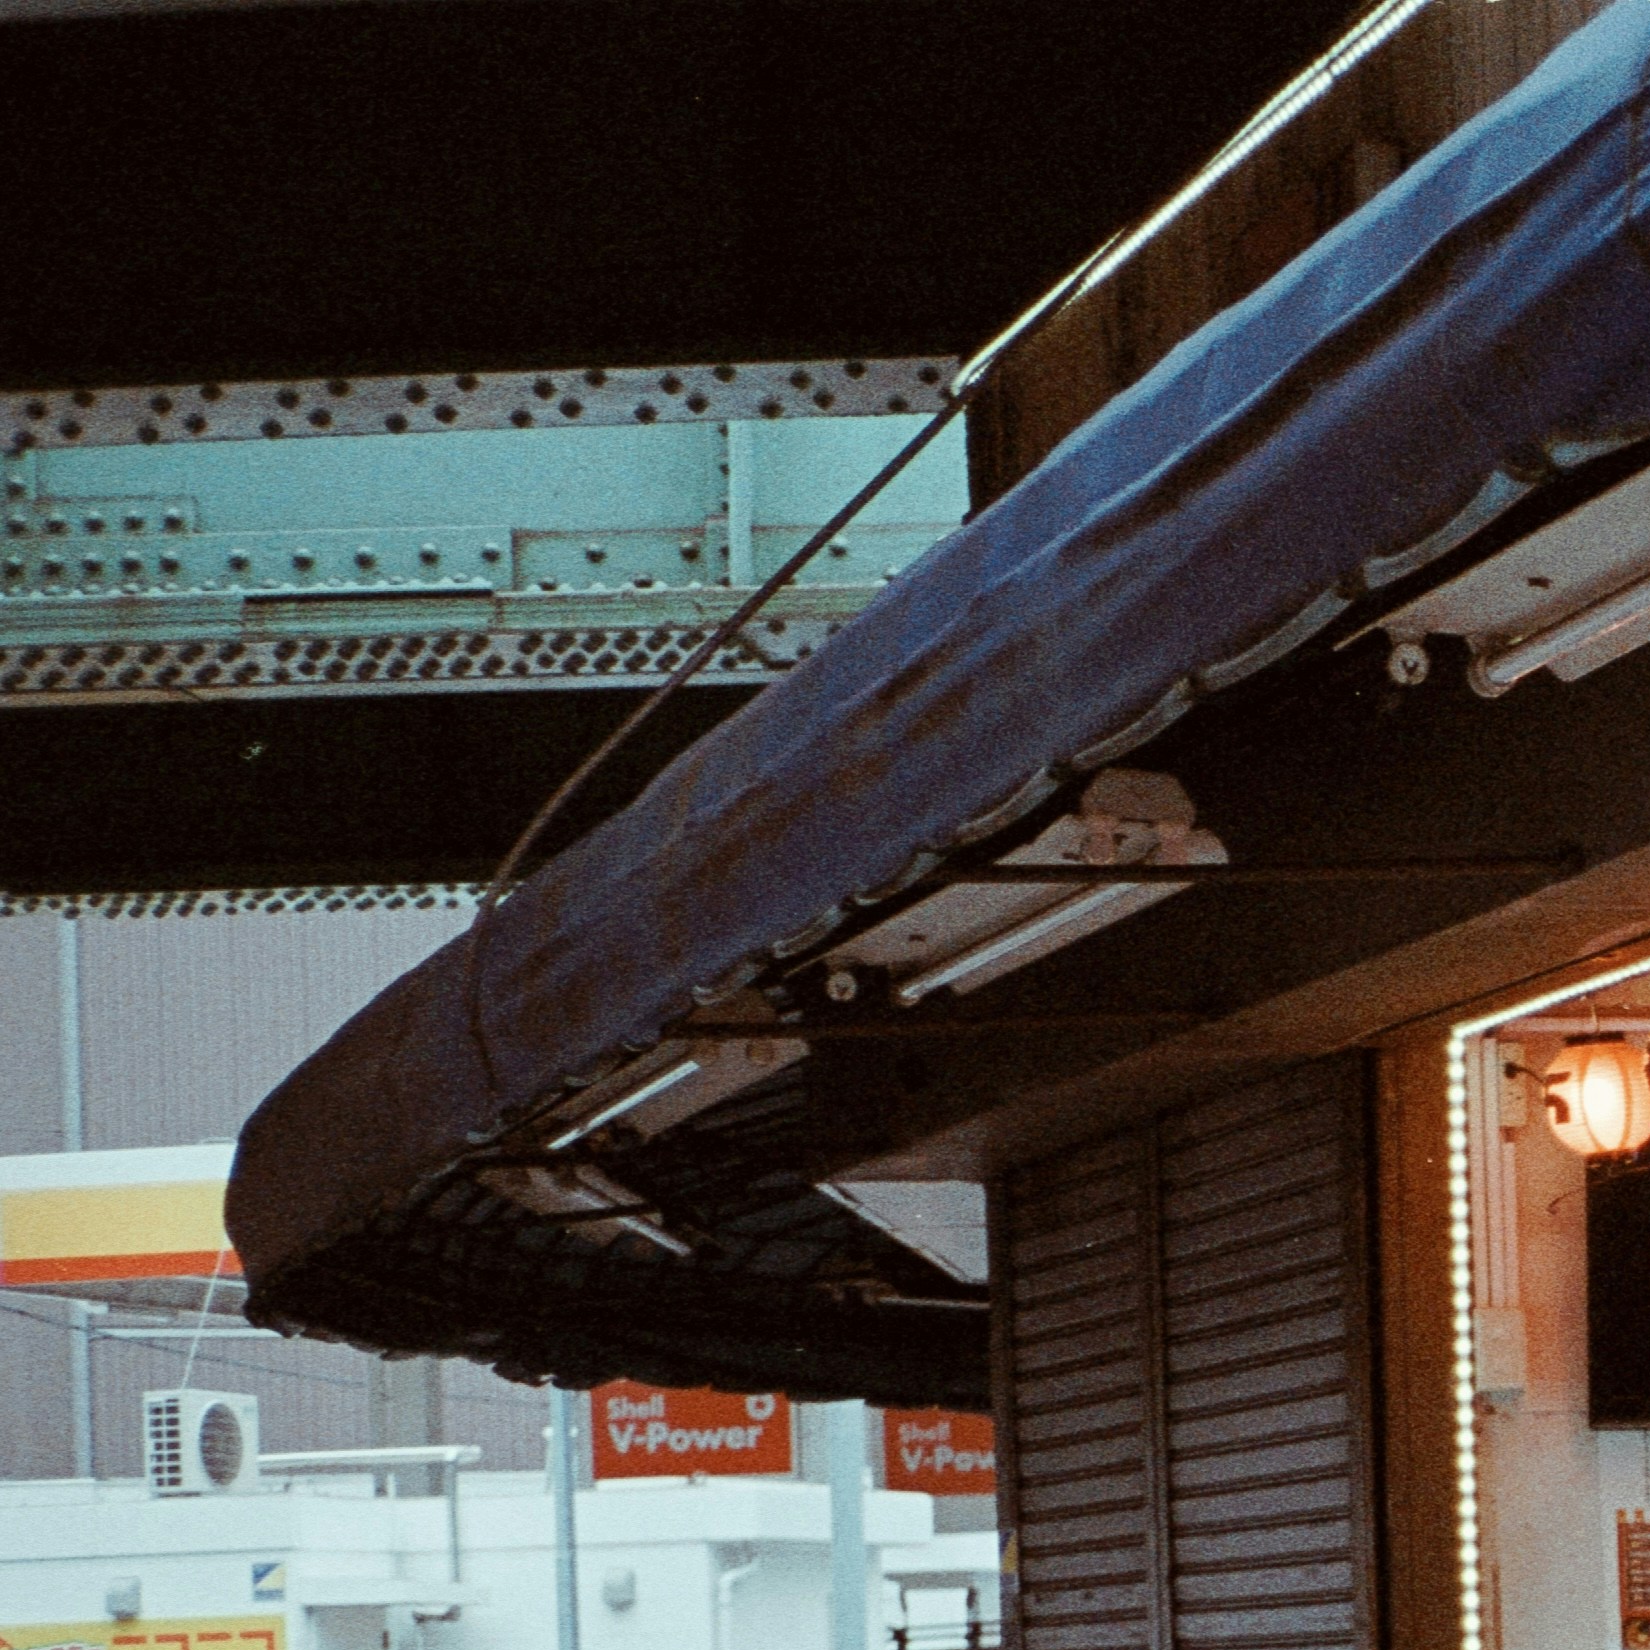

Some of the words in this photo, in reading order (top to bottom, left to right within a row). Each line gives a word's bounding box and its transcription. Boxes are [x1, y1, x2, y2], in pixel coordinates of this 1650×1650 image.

[608, 1393, 665, 1420] Shell
[608, 1421, 763, 1455] V-Power
[899, 1421, 950, 1444] Shell
